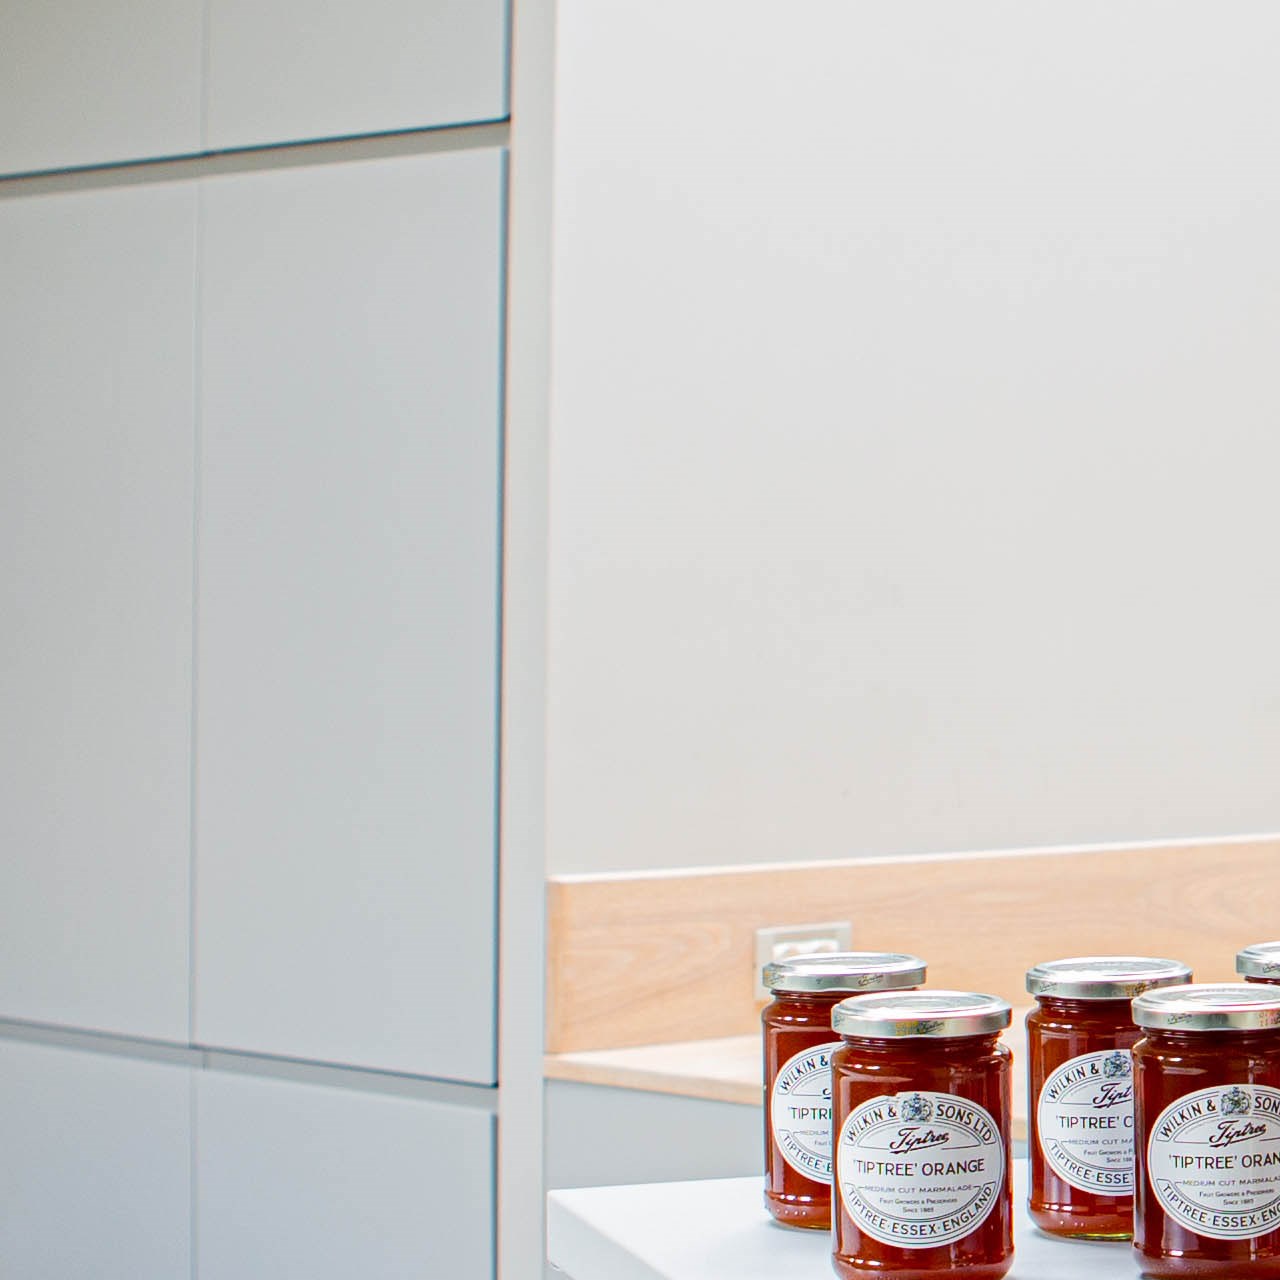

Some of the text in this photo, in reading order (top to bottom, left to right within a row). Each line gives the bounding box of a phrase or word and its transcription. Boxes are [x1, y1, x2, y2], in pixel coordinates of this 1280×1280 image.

[780, 1055, 829, 1091] WILKIN &
[1048, 1063, 1100, 1100] WILKIN &
[847, 1103, 991, 1142] WILKIN & SONS LTD
[1056, 1116, 1119, 1129] 'TIPTREE'
[1160, 1103, 1202, 1139] WILKIN
[1207, 1099, 1216, 1111] &
[1209, 1119, 1266, 1148] Tiptree
[783, 1134, 823, 1170] TIPTREE
[889, 1126, 950, 1154] Tiptree
[854, 1158, 985, 1176] 'TIPTREE' ORANGE
[1050, 1142, 1092, 1180] TIPTREE
[1169, 1153, 1237, 1169] 'TIPTREE'
[892, 1221, 937, 1236] ESSEX
[942, 1186, 992, 1232] ENGLAND
[1162, 1183, 1207, 1223] TIPTREE
[1212, 1215, 1257, 1228] ESSEX
